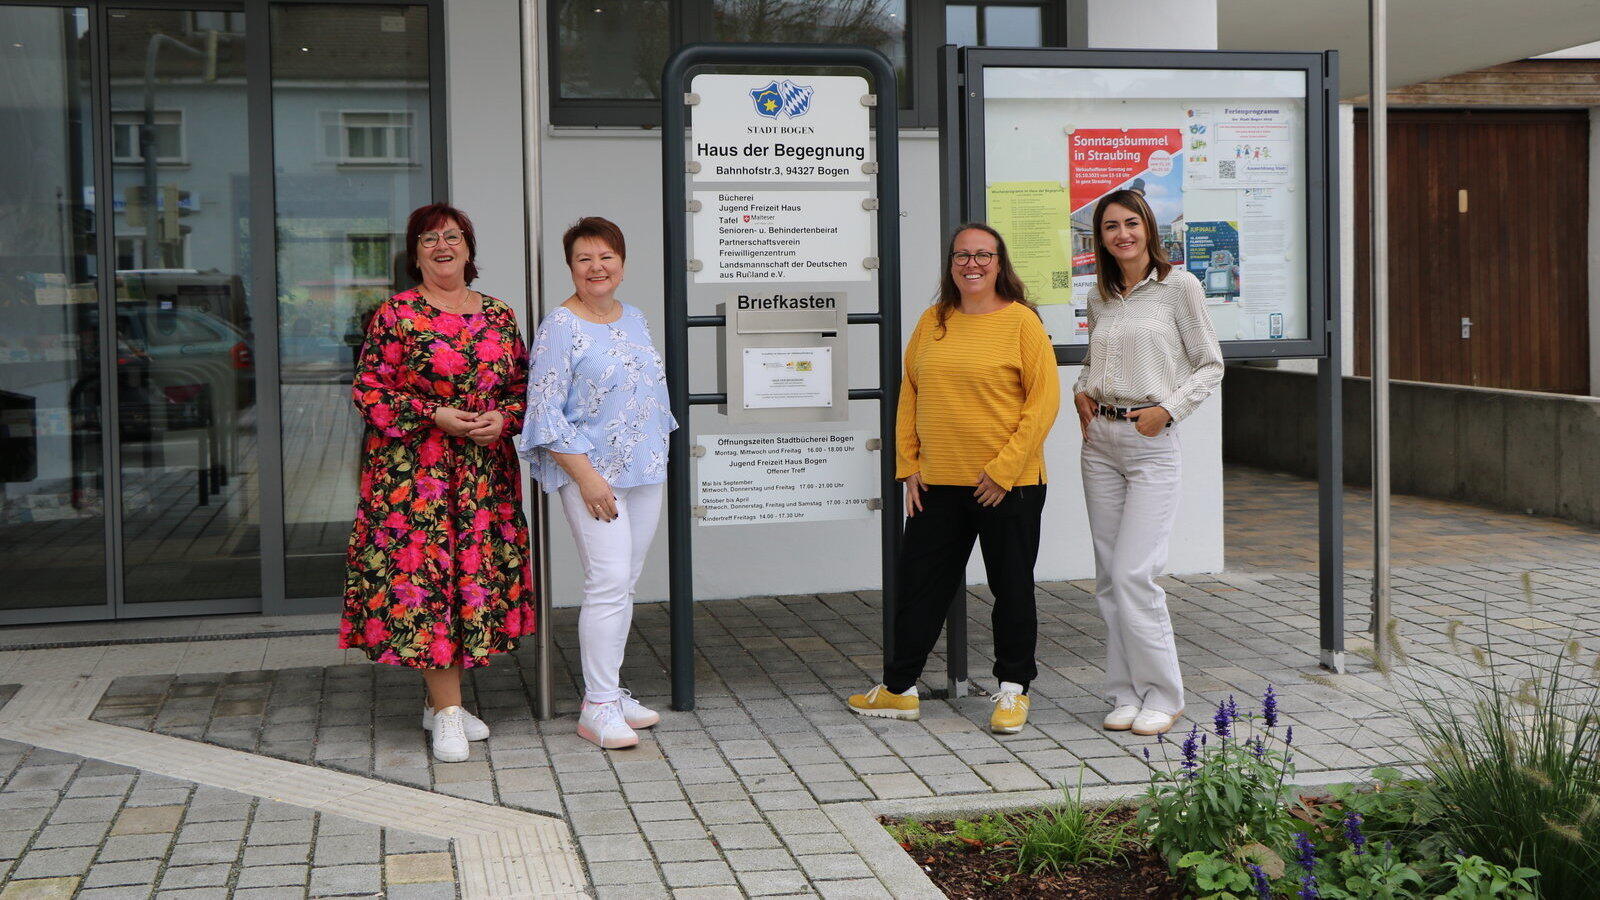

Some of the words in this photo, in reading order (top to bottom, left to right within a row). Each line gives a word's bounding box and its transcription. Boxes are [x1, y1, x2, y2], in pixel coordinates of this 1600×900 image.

[747, 126, 777, 134] STADT
[781, 126, 814, 134] BOGEN
[1074, 135, 1168, 148] Sonntagsbummel
[697, 143, 738, 156] Haus
[743, 143, 769, 157] der
[775, 144, 864, 160] Begegnung
[1074, 150, 1085, 160] in
[1088, 150, 1141, 162] Straubing
[716, 166, 784, 176] Bahnhofstr.3,
[786, 166, 815, 175] 94327
[818, 166, 849, 177] Bogen
[719, 193, 754, 201] Bücherei
[719, 205, 748, 213] Jugend
[719, 238, 800, 246] Partnerschaftsverein
[719, 249, 796, 258] Freiwilligenzentrum
[738, 295, 835, 309] Briefkasten
[776, 435, 828, 445] Stadtbücherei
[830, 435, 855, 444] Bogen
[781, 447, 802, 455] Freitag
[729, 460, 756, 468] Jugend
[804, 457, 827, 466] Bogen
[702, 514, 733, 522] Kindertreff
